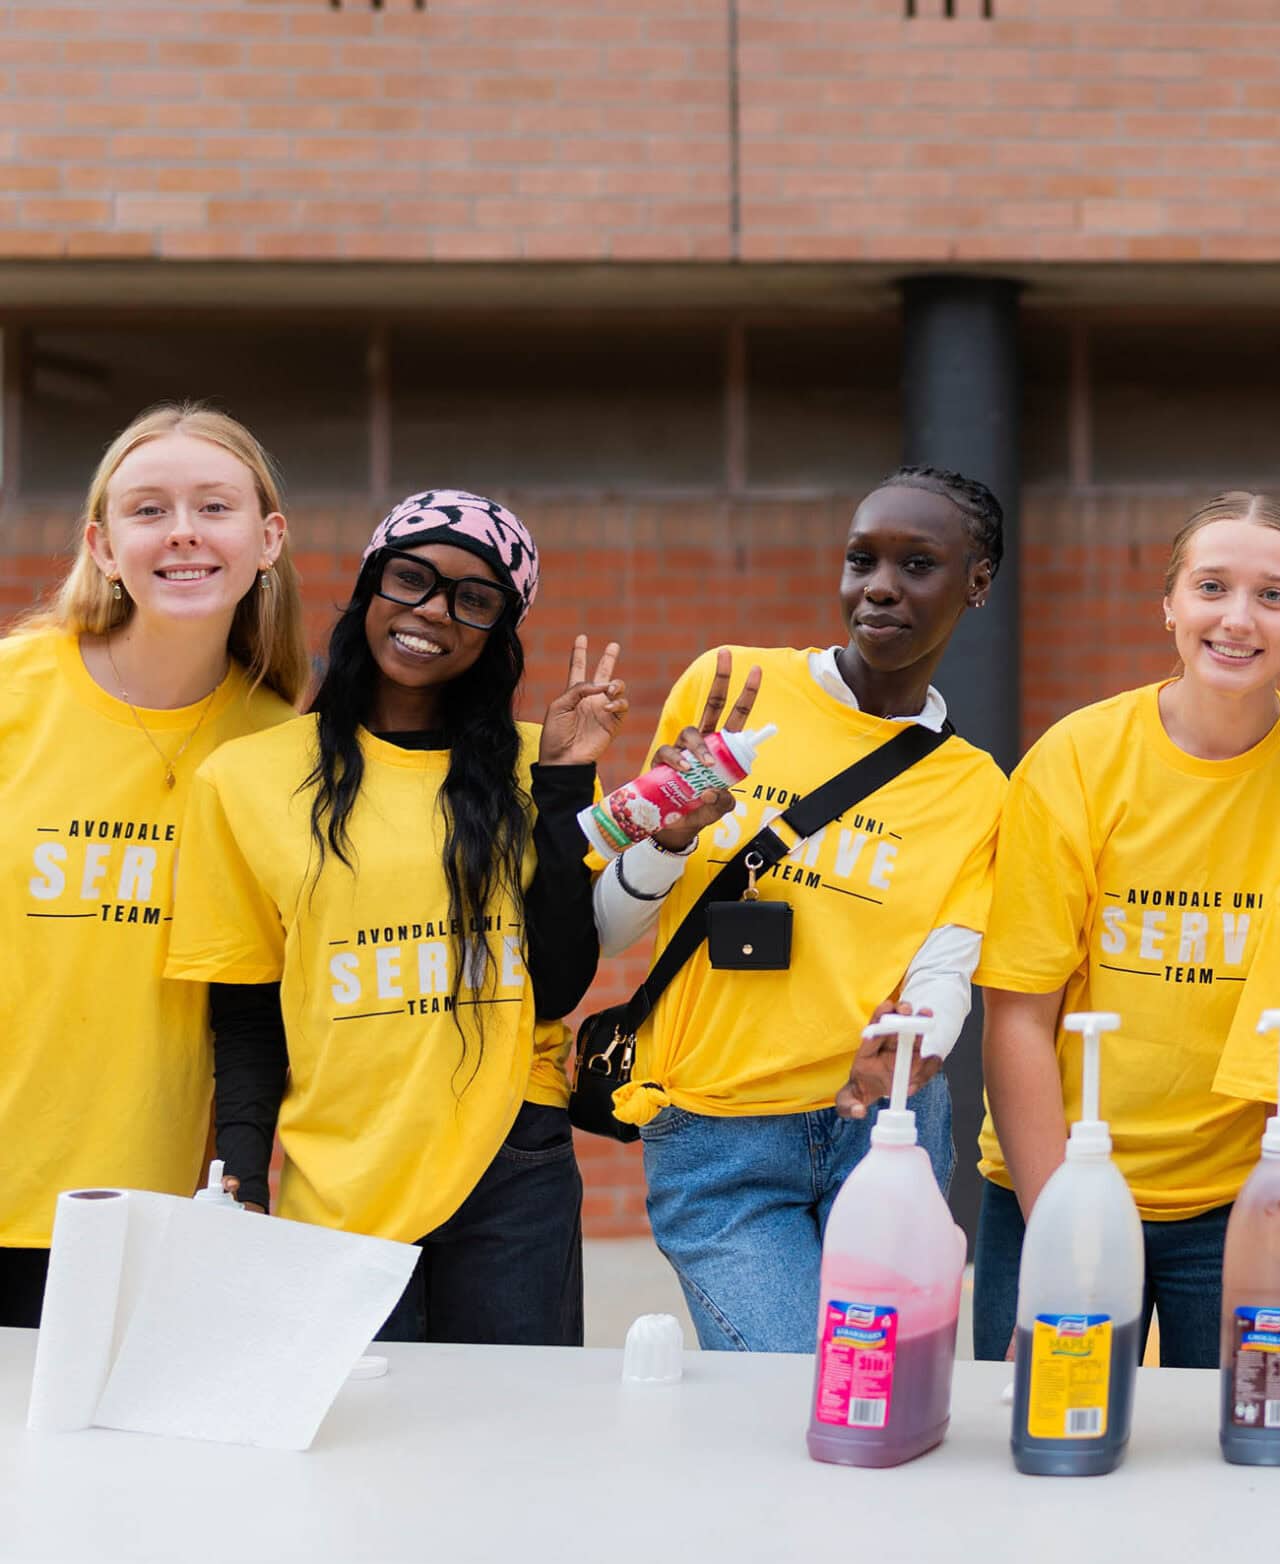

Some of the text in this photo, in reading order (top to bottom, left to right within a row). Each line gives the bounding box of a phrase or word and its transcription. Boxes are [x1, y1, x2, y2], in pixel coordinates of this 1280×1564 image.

[68, 820, 176, 841] AVONDALE
[853, 814, 885, 834] UNI
[29, 841, 180, 902] SER
[771, 863, 822, 889] TEAM
[1127, 889, 1264, 909] AVONDALE UNI
[102, 904, 160, 924] TEAM
[357, 918, 460, 945] AVONDALE
[329, 934, 525, 1005] SERVE
[1165, 966, 1213, 984] TEAM
[408, 996, 458, 1015] TEAM
